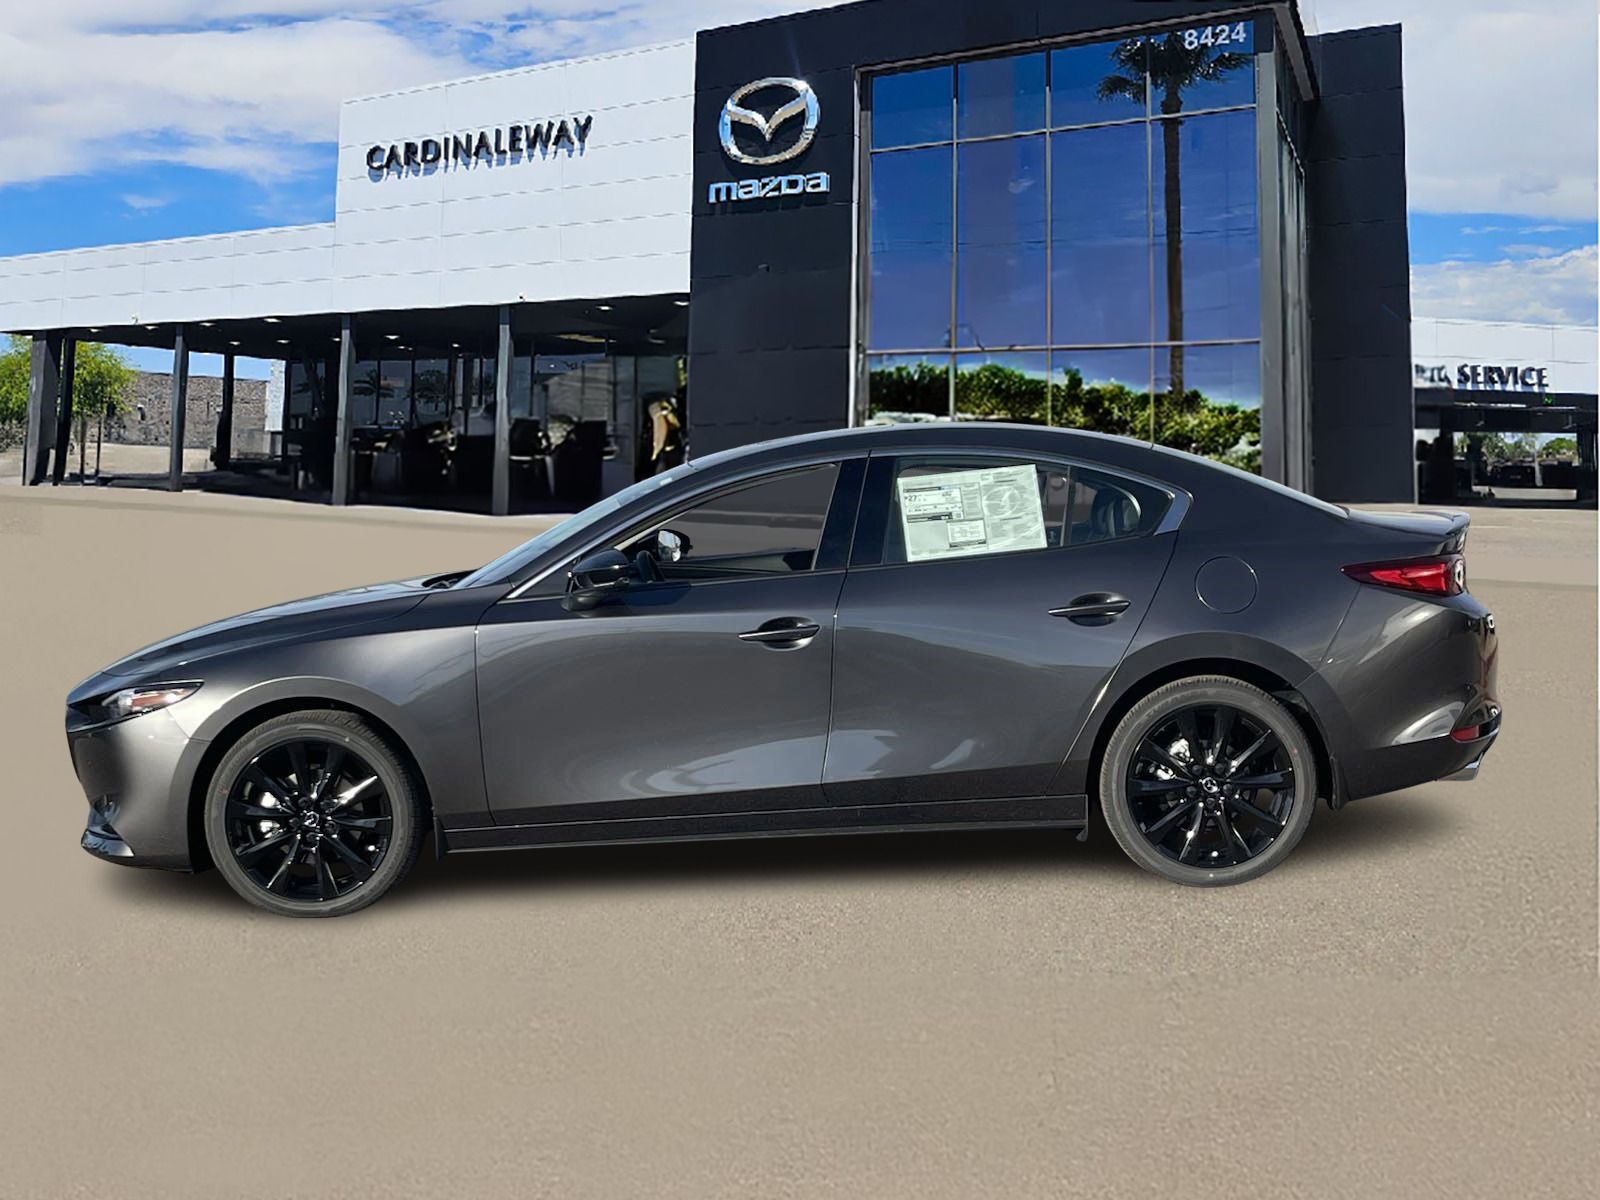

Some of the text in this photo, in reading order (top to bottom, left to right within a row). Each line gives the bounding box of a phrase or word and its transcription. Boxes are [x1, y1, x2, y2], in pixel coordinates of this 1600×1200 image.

[1184, 22, 1246, 50] 8424
[366, 115, 593, 172] CARDINALEWAY
[1457, 363, 1549, 388] SERVICE
